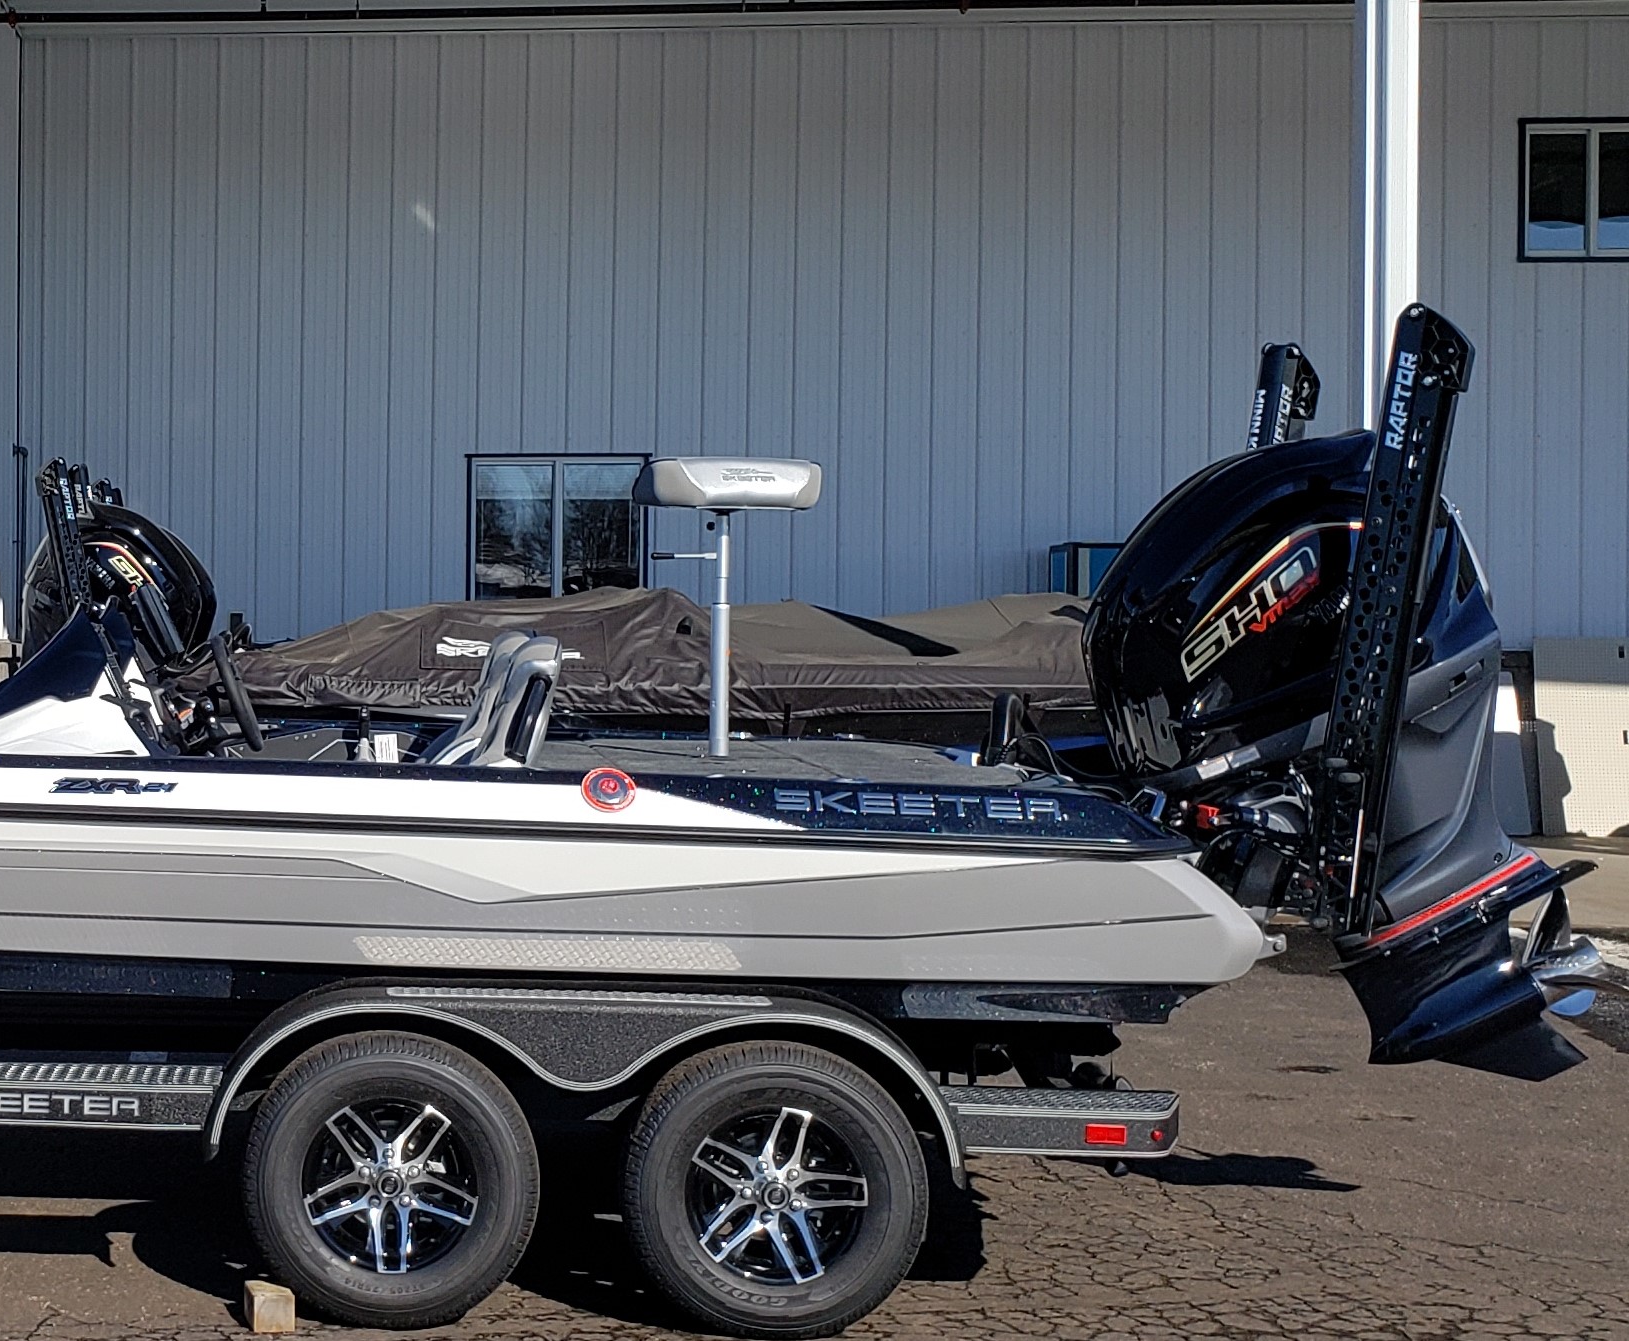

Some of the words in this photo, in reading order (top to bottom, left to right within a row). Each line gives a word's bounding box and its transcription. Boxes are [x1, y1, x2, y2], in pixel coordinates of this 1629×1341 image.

[1250, 389, 1266, 434] MINN
[1272, 383, 1293, 445] PTOR
[1384, 350, 1418, 451] RAPTOR
[59, 477, 76, 520] RAPTOR
[74, 483, 85, 514] RAPT
[1180, 545, 1318, 684] SHO
[773, 788, 1064, 822] SKEETER
